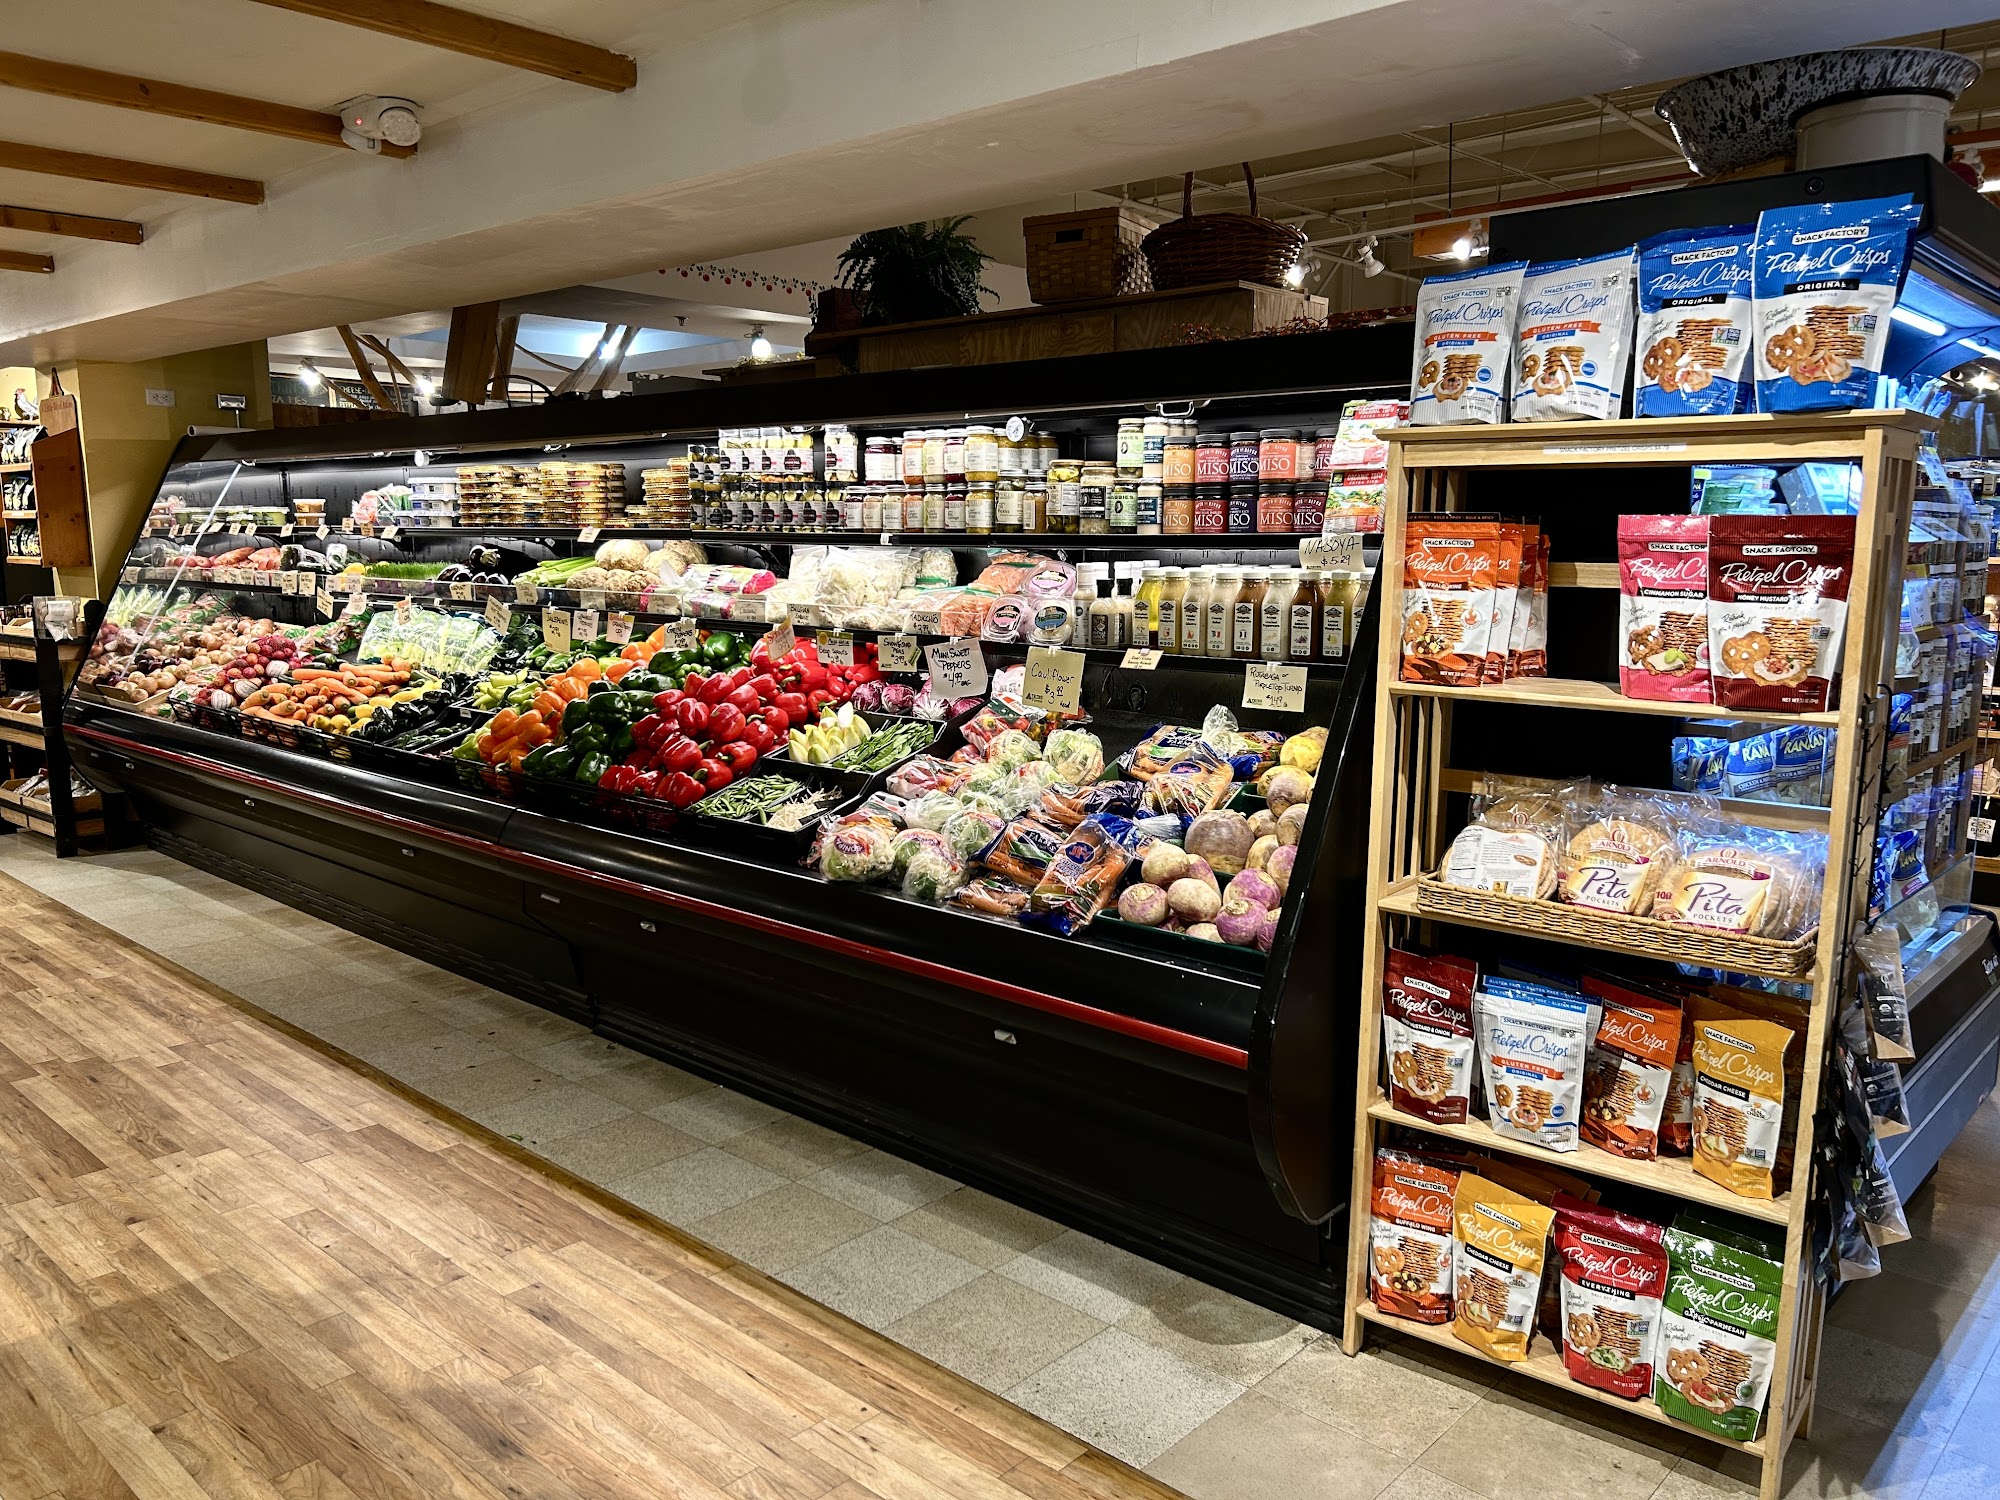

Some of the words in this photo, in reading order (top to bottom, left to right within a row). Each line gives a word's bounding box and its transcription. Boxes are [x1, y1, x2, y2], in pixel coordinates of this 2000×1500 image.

[1795, 235, 1823, 244] SNACK
[1825, 228, 1865, 239] FACTORY
[1673, 253, 1700, 263] SNACK
[1702, 247, 1735, 259] FACTORY
[1765, 251, 1826, 281] Pretzel
[1828, 244, 1891, 272] Crisps
[1544, 286, 1564, 295] SNACK
[1564, 281, 1593, 292] FACTORY
[1649, 268, 1701, 296] Pretzel
[1797, 281, 1846, 291] ORIGINAL
[1443, 293, 1461, 302] SNACK
[1461, 289, 1488, 299] FACTORY
[1672, 296, 1714, 306] ORIGINAL
[1427, 303, 1462, 328] Pretzel
[1463, 302, 1504, 326] Crisps
[1522, 298, 1564, 322] Pretzel
[1566, 294, 1609, 314] Crisps
[1532, 325, 1561, 334] GLUTEN
[1563, 322, 1584, 330] FREE
[1541, 331, 1570, 339] ORIGINAL
[1164, 463, 1191, 476] MISO
[1197, 462, 1230, 475] MISO
[1229, 461, 1260, 474] MISO
[1260, 458, 1291, 471] MISO
[1315, 457, 1331, 470] MIS
[1164, 514, 1190, 527] MISO
[1195, 514, 1224, 527] MISO
[1229, 513, 1251, 526] ISO
[1260, 512, 1294, 525] MISO
[1294, 512, 1324, 525] MISO
[1304, 535, 1360, 556] NASOYA
[1745, 546, 1773, 555] SNACK
[1775, 546, 1814, 554] FACTORY
[1405, 552, 1451, 578] Pretzel
[1449, 552, 1491, 576] Crisps
[1628, 556, 1681, 587] Pretzel
[1720, 561, 1780, 592] Pretzel
[1783, 560, 1843, 585] Crisps
[1644, 589, 1678, 597] CINNAMON
[1679, 590, 1704, 599] SUGAR
[1737, 594, 1759, 602] HONEY
[1760, 595, 1789, 603] MUSTARD
[1031, 663, 1075, 684] Cauliflower
[1742, 744, 1770, 762] RANA
[1598, 840, 1631, 852] ARNOLD
[1705, 857, 1747, 867] ARNOLD
[1578, 866, 1631, 899] Pita
[1585, 895, 1620, 907] POCKETS
[1683, 882, 1747, 916] Pita
[1693, 913, 1733, 924] POCKETS
[1405, 978, 1426, 990] SNACK
[1424, 984, 1449, 998] FACTORY
[1389, 988, 1427, 1017] Pretzel
[1428, 1000, 1468, 1028] Crisps
[1435, 1028, 1451, 1037] ONION
[1503, 1017, 1523, 1026] SNACK
[1524, 1022, 1552, 1032] FACTORY
[1490, 1028, 1527, 1055] Pretzel
[1530, 1035, 1569, 1060] Crisps
[1629, 1024, 1669, 1054] Crisps
[1705, 1029, 1724, 1043] SNACK
[1724, 1036, 1755, 1051] FACTORY
[1623, 1051, 1638, 1062] WING
[1693, 1040, 1726, 1076] Pretzel
[1727, 1053, 1774, 1087] Crisps
[1501, 1058, 1529, 1070] GLUTEN
[1531, 1063, 1549, 1075] FREE
[1511, 1068, 1538, 1079] ORIGINAL
[1700, 1075, 1723, 1090] CHEDDAR
[1722, 1085, 1746, 1098] CHEESE
[1396, 1176, 1416, 1186] SNACK
[1417, 1181, 1447, 1192] FACTORY
[1378, 1186, 1421, 1215] Pretzel
[1421, 1195, 1454, 1223] Crisp
[1475, 1204, 1492, 1216] SNACK
[1493, 1211, 1521, 1229] FACTORY
[1396, 1217, 1421, 1230] BUFFALO
[1421, 1224, 1436, 1233] WING
[1459, 1213, 1494, 1248] Pretzel
[1494, 1229, 1537, 1260] Crisps
[1583, 1234, 1606, 1246] SNACK
[1467, 1246, 1489, 1263] CHEDDAR
[1488, 1256, 1510, 1271] CHEESE
[1563, 1246, 1611, 1277] Pretzel
[1611, 1255, 1659, 1287] Crisps
[1693, 1264, 1717, 1278] SNACK
[1718, 1273, 1755, 1291] FACTORY
[1581, 1279, 1631, 1298] EVERYTHING
[1671, 1273, 1721, 1311] Pretzel
[1721, 1292, 1774, 1325] Crisps
[1709, 1318, 1745, 1336] PARMESAN
